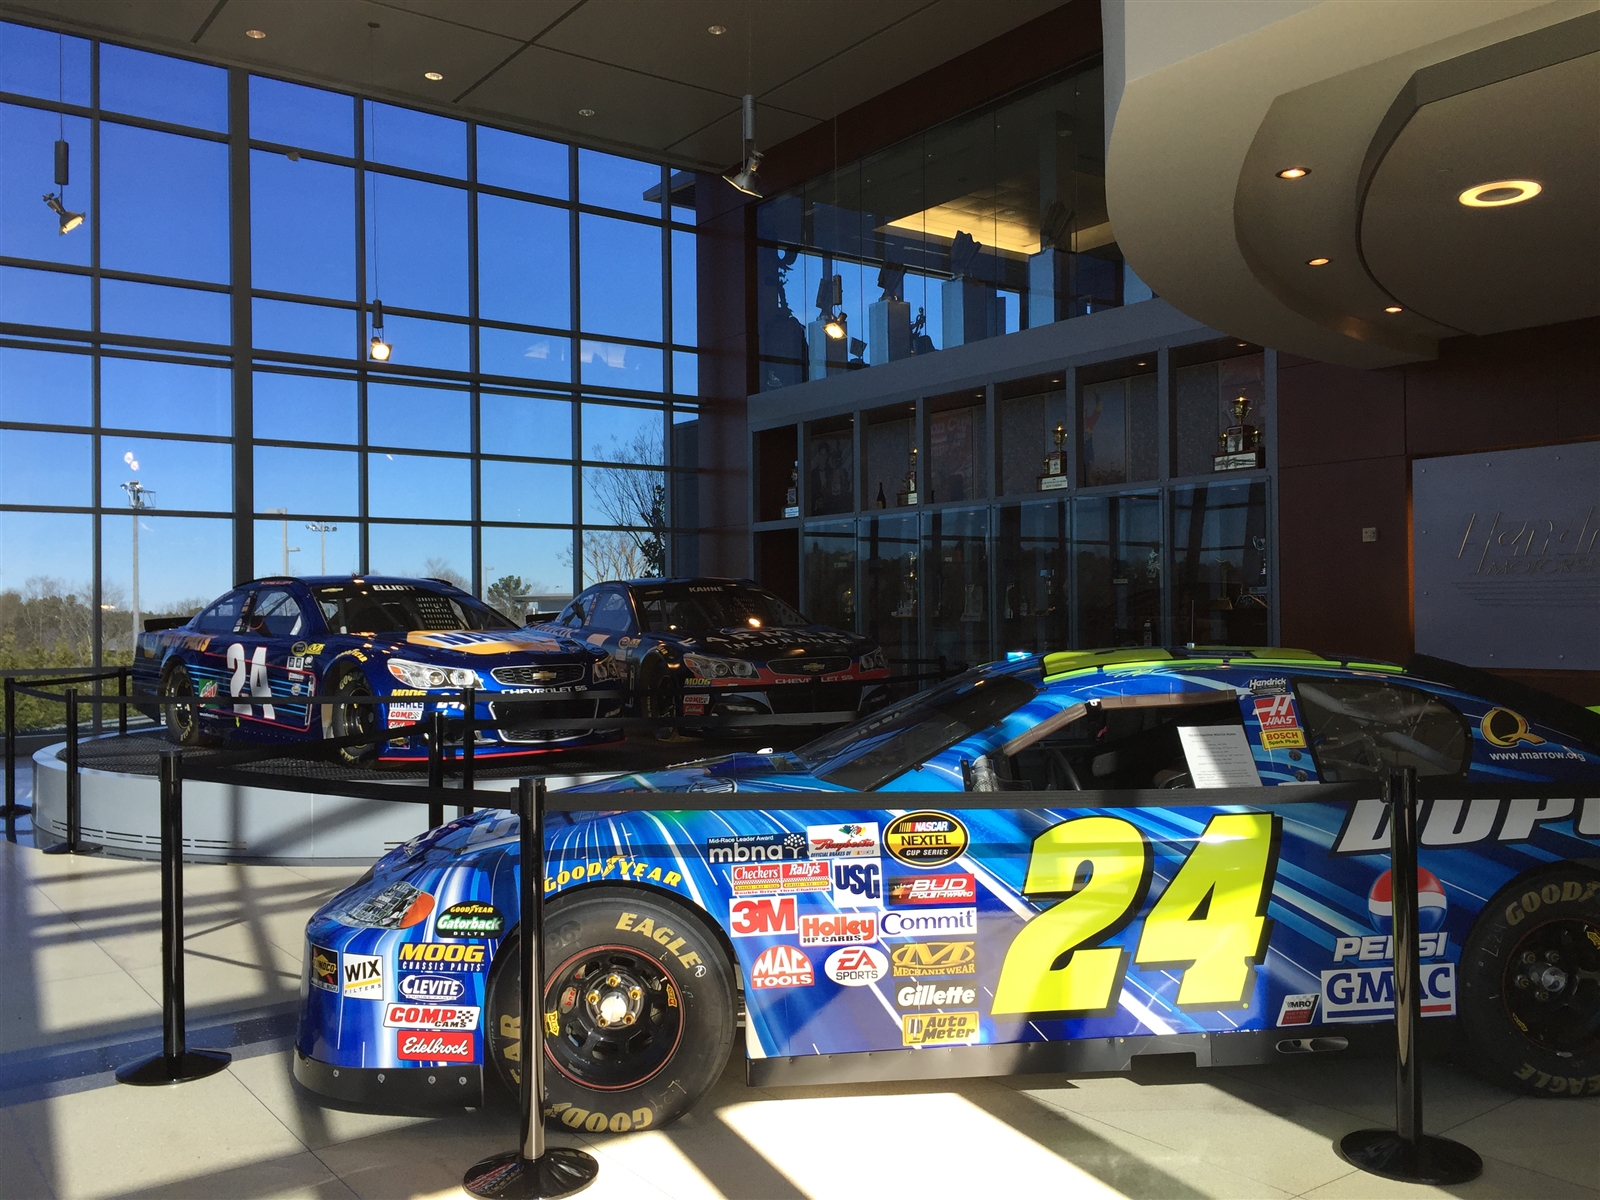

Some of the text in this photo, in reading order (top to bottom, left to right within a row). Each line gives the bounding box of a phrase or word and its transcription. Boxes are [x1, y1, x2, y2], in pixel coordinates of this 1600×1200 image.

[372, 584, 416, 592] ELLIOTT
[688, 585, 724, 593] KAHNE
[226, 642, 276, 721] 24
[684, 677, 711, 686] MOOG
[1249, 676, 1287, 690] Hendrick
[390, 711, 413, 719] COMP
[1264, 716, 1294, 726] HAAS
[1266, 732, 1299, 741] BOSCH
[1489, 750, 1587, 763] www.marrow.org
[914, 821, 949, 832] NASCAR
[756, 834, 774, 842] Award
[901, 834, 952, 846] NEXTEL
[709, 843, 783, 863] mbna
[922, 848, 949, 856] SERIES
[543, 857, 683, 894] GOODYEAR
[734, 865, 779, 880] Checkers
[788, 862, 821, 877] Rally's
[835, 863, 880, 900] USG
[912, 877, 968, 891] BUD
[449, 904, 495, 914] GOODYEAR
[731, 897, 795, 934] 3M
[990, 812, 1280, 1018] 24
[436, 914, 503, 931] Gatorback
[802, 916, 876, 941] Holley
[880, 909, 974, 936] Commit
[615, 911, 702, 970] EAGLE
[818, 934, 862, 943] CARBS
[398, 943, 485, 962] MOOG
[836, 949, 870, 971] EA
[345, 959, 381, 983] WIX
[402, 961, 482, 972] CHASSIS PARTS
[752, 950, 811, 978] MAC
[892, 964, 976, 978] MECHANIX WEAR
[753, 974, 813, 986] TOOLS
[835, 970, 879, 981] SPORTS
[345, 984, 382, 995] FILTERS
[401, 974, 460, 996] CLEVITE
[1326, 966, 1452, 1005] GMC
[897, 985, 976, 1007] Gillette
[389, 1007, 457, 1024] COMP
[925, 1014, 967, 1029] Auto
[434, 1020, 468, 1028] CAMS
[920, 1027, 976, 1042] Meter
[402, 1036, 470, 1056] Edelbrock
